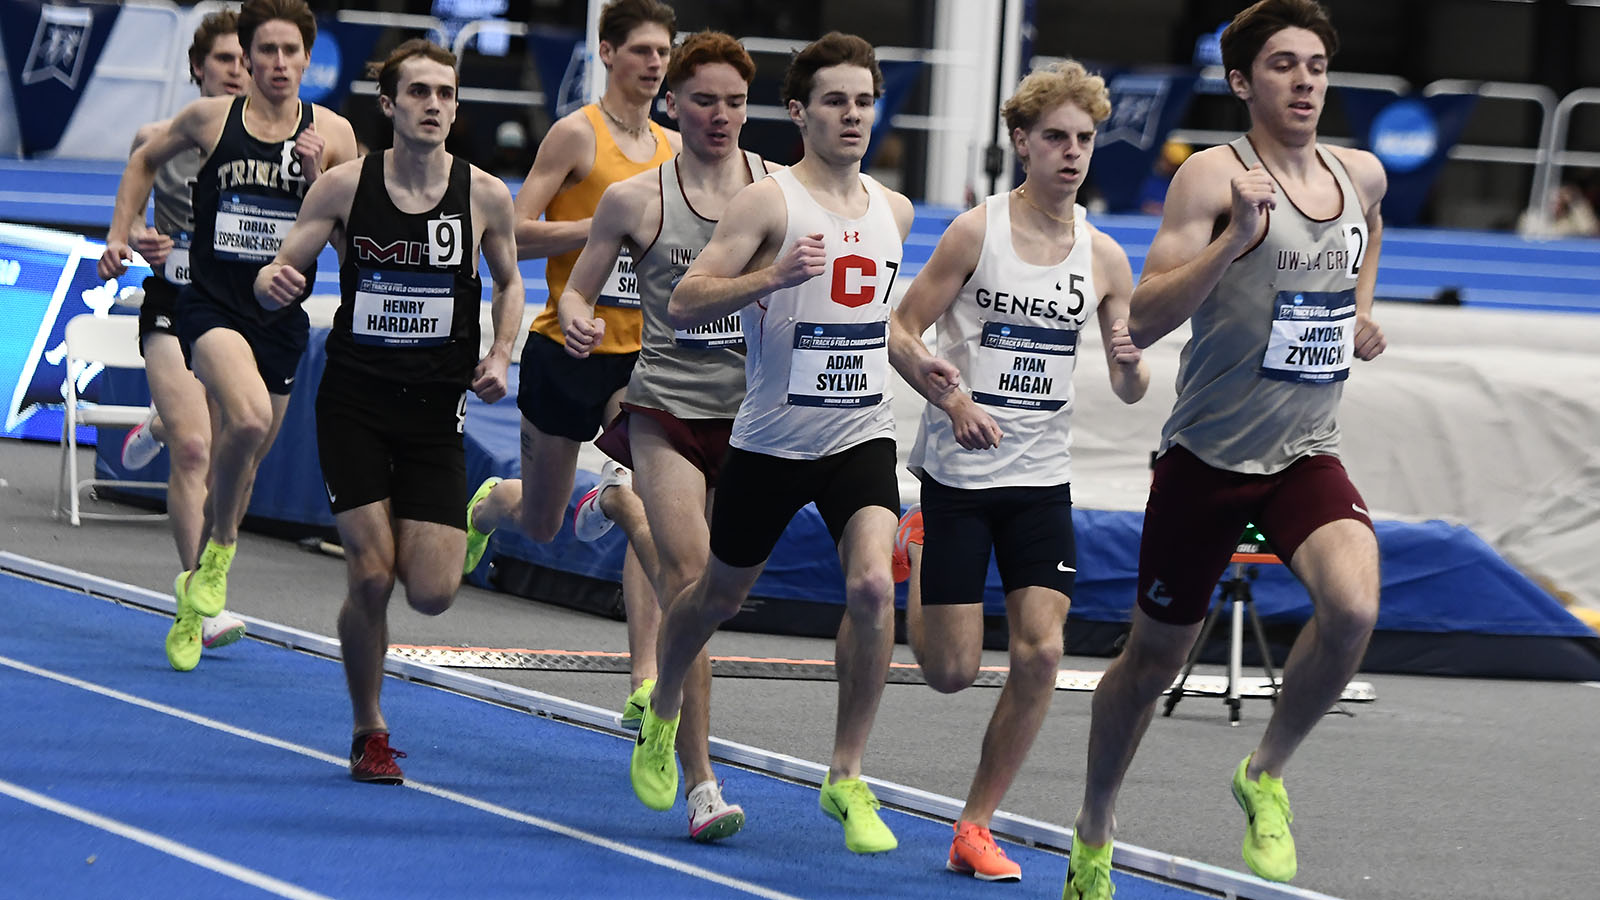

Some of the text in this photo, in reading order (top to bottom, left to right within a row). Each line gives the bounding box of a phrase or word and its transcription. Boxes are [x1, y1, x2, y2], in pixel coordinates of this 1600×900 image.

[288, 147, 303, 177] 8
[238, 219, 276, 235] TOBIAS
[436, 222, 455, 262] 9
[1351, 226, 1363, 275] 2
[1277, 250, 1321, 271] UW-LA
[372, 283, 388, 292] TRACK
[407, 286, 451, 295] CHAMPIONSHIPS
[831, 254, 877, 308] C
[882, 261, 898, 305] 7
[1067, 274, 1084, 316] 5
[383, 299, 425, 314] HENRY
[367, 314, 438, 333] HARDART
[835, 339, 850, 347] FIELD
[1299, 326, 1344, 342] JAYDEN
[998, 337, 1016, 347] TRACK
[1020, 340, 1035, 349] FIELD
[1034, 341, 1074, 353] CHAMPIONSHIPS
[826, 355, 864, 370] ADAM
[1013, 357, 1046, 373] RYAN
[816, 373, 868, 391] SYLVIA
[998, 373, 1053, 394] HAGAN
